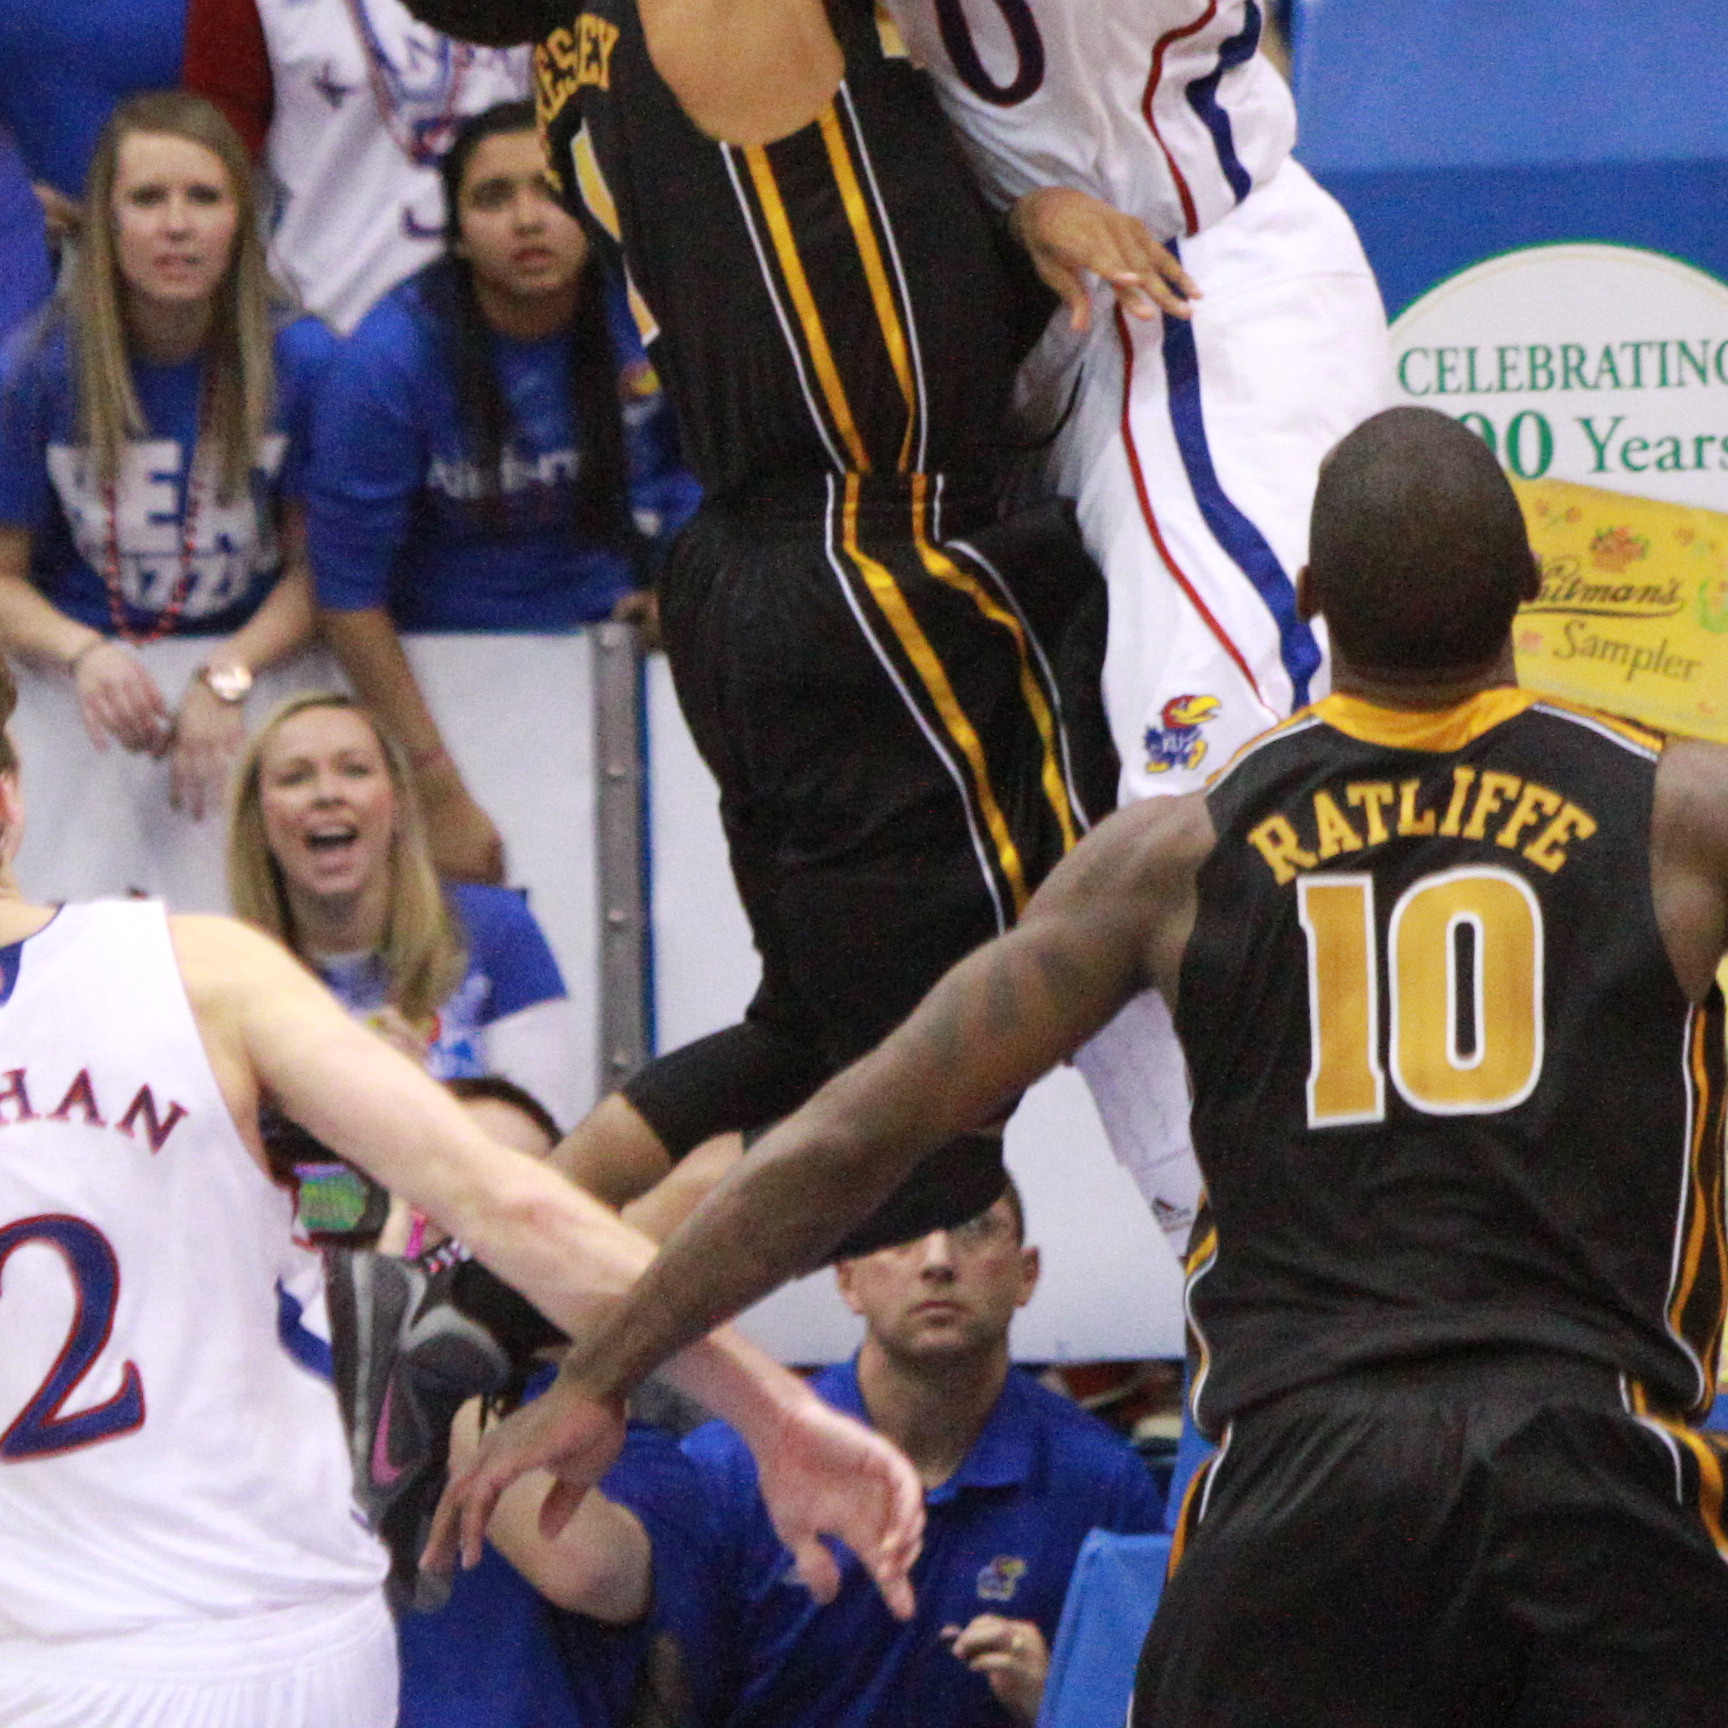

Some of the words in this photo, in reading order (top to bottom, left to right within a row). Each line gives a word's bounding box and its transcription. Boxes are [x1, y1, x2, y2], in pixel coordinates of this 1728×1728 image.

[1553, 619, 1701, 682] Sampler
[1247, 765, 1598, 885] RATLIFFE
[1296, 865, 1545, 1129] 10
